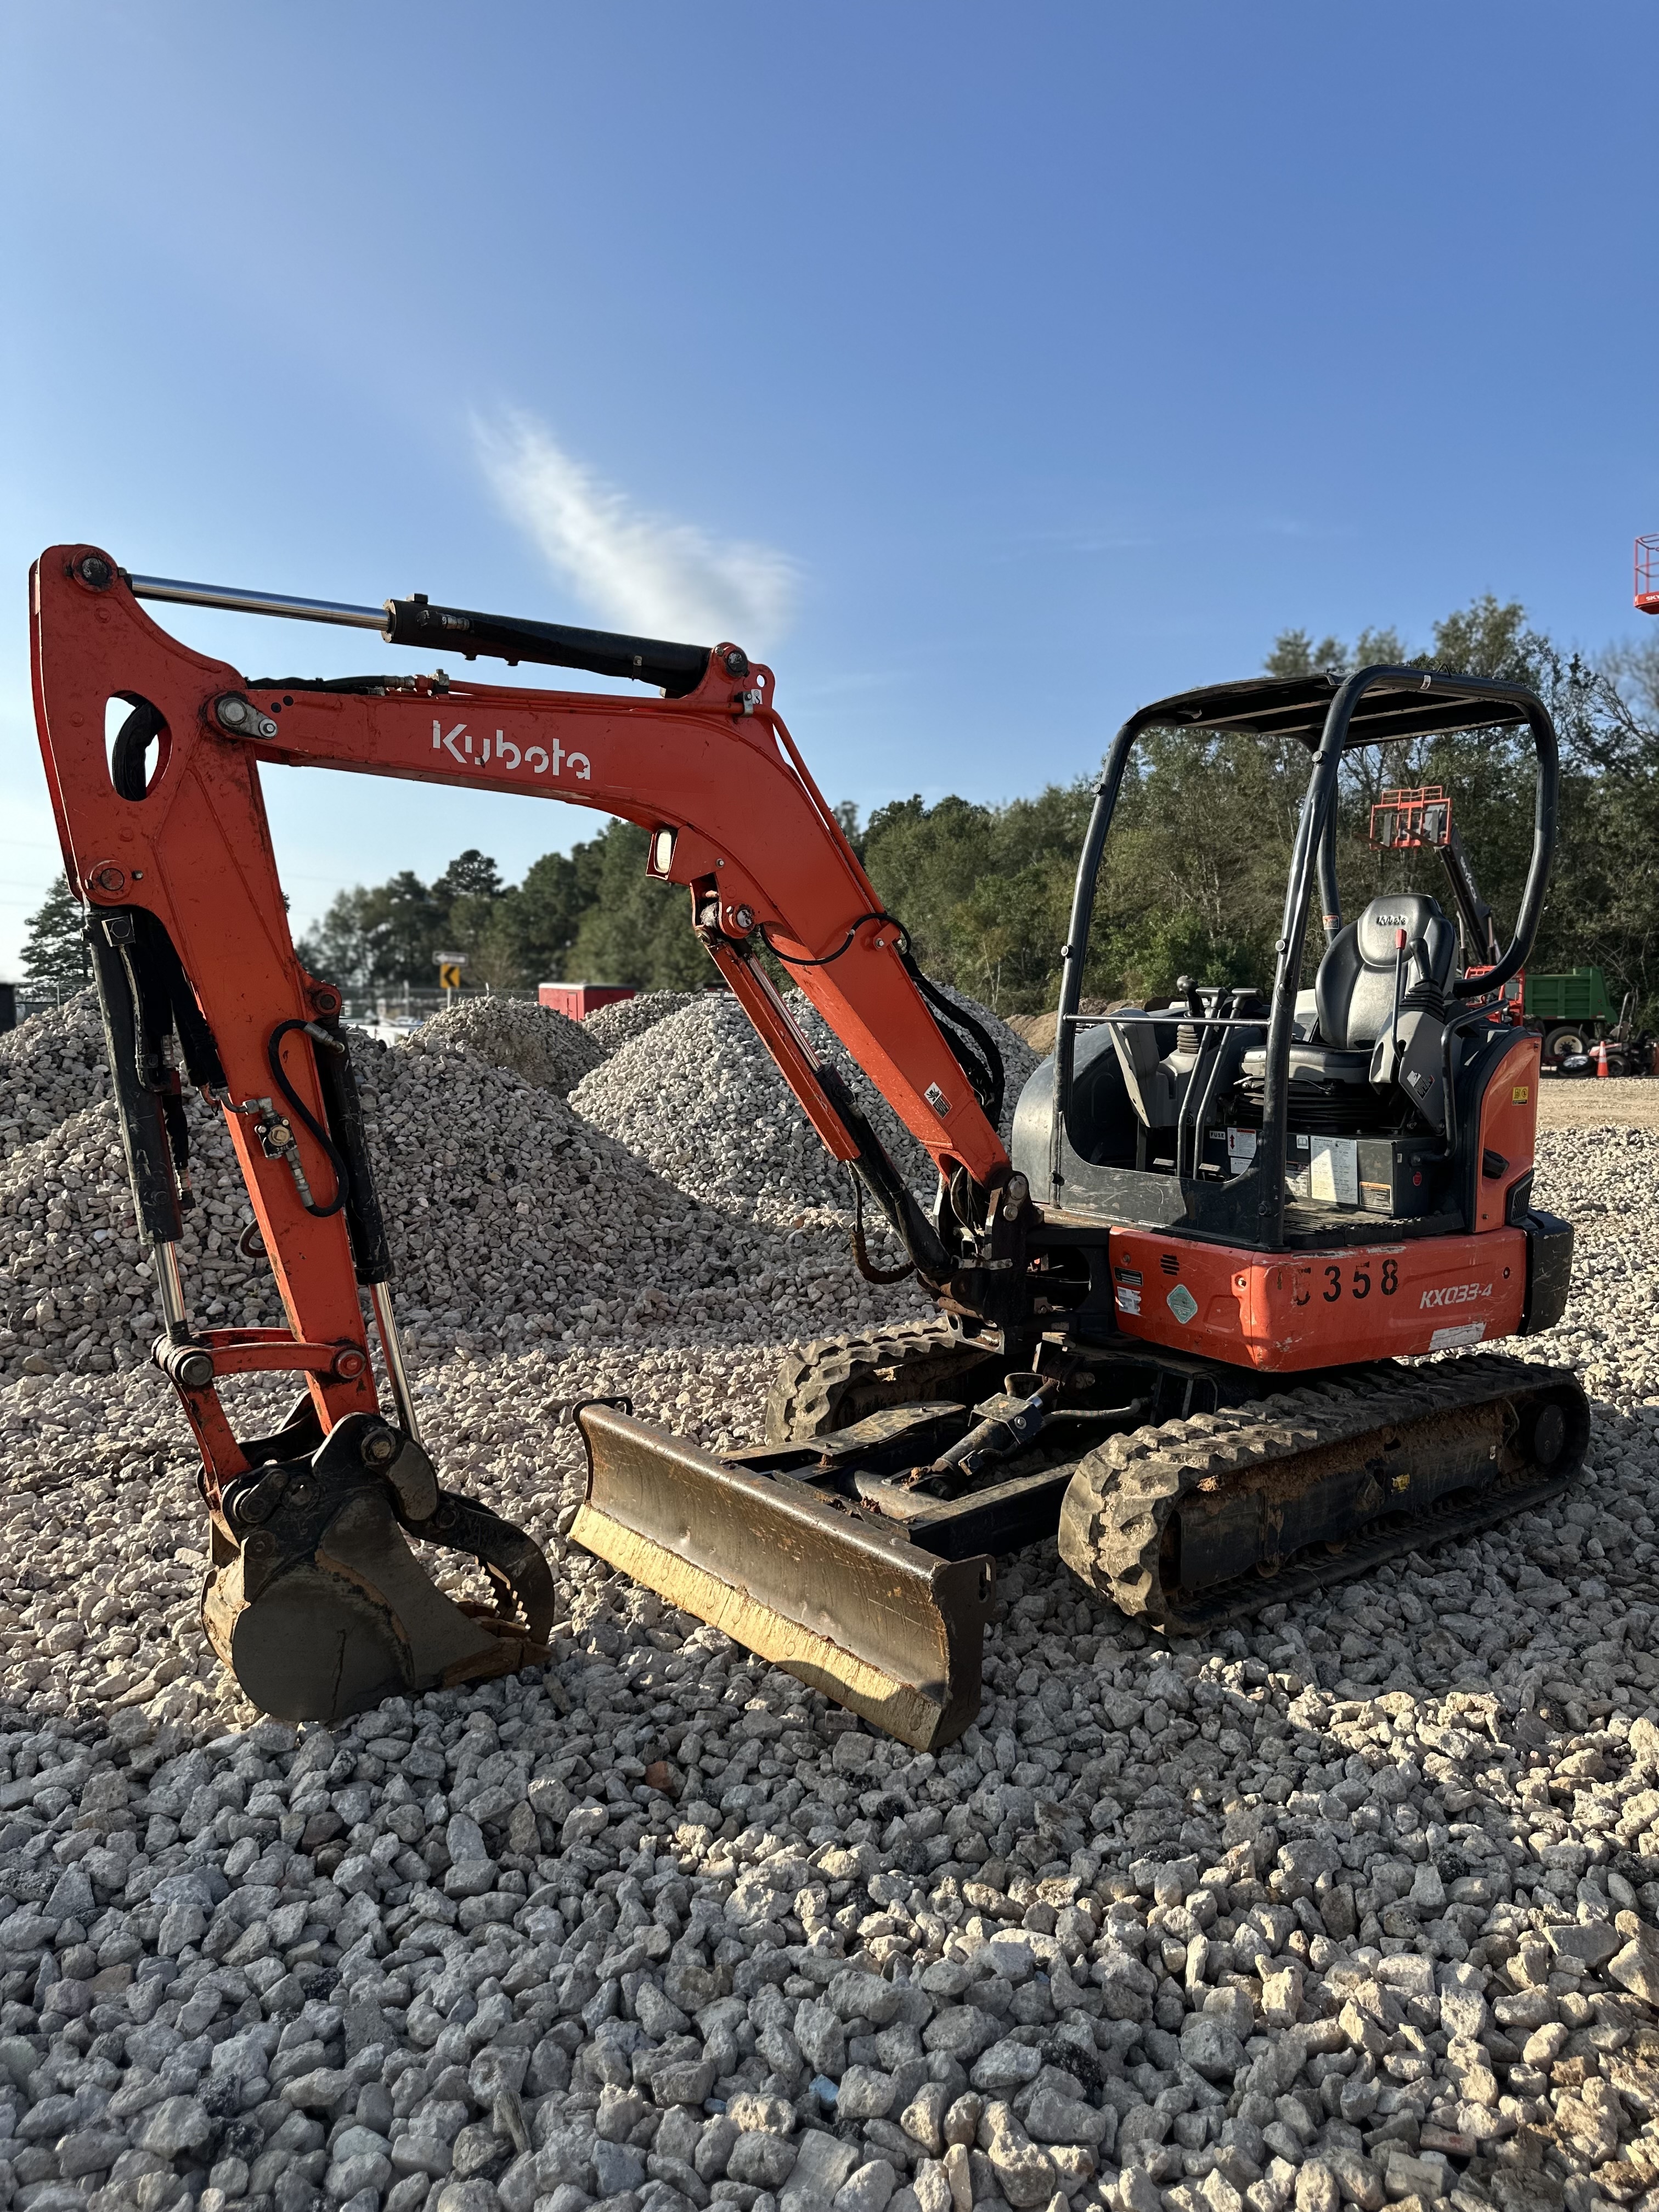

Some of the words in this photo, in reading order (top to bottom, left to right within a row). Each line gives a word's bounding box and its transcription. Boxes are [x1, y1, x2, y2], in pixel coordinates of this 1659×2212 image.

[432, 720, 591, 780] Kubota
[1376, 915, 1408, 926] Kubota
[1419, 1283, 1493, 1310] KX033-4
